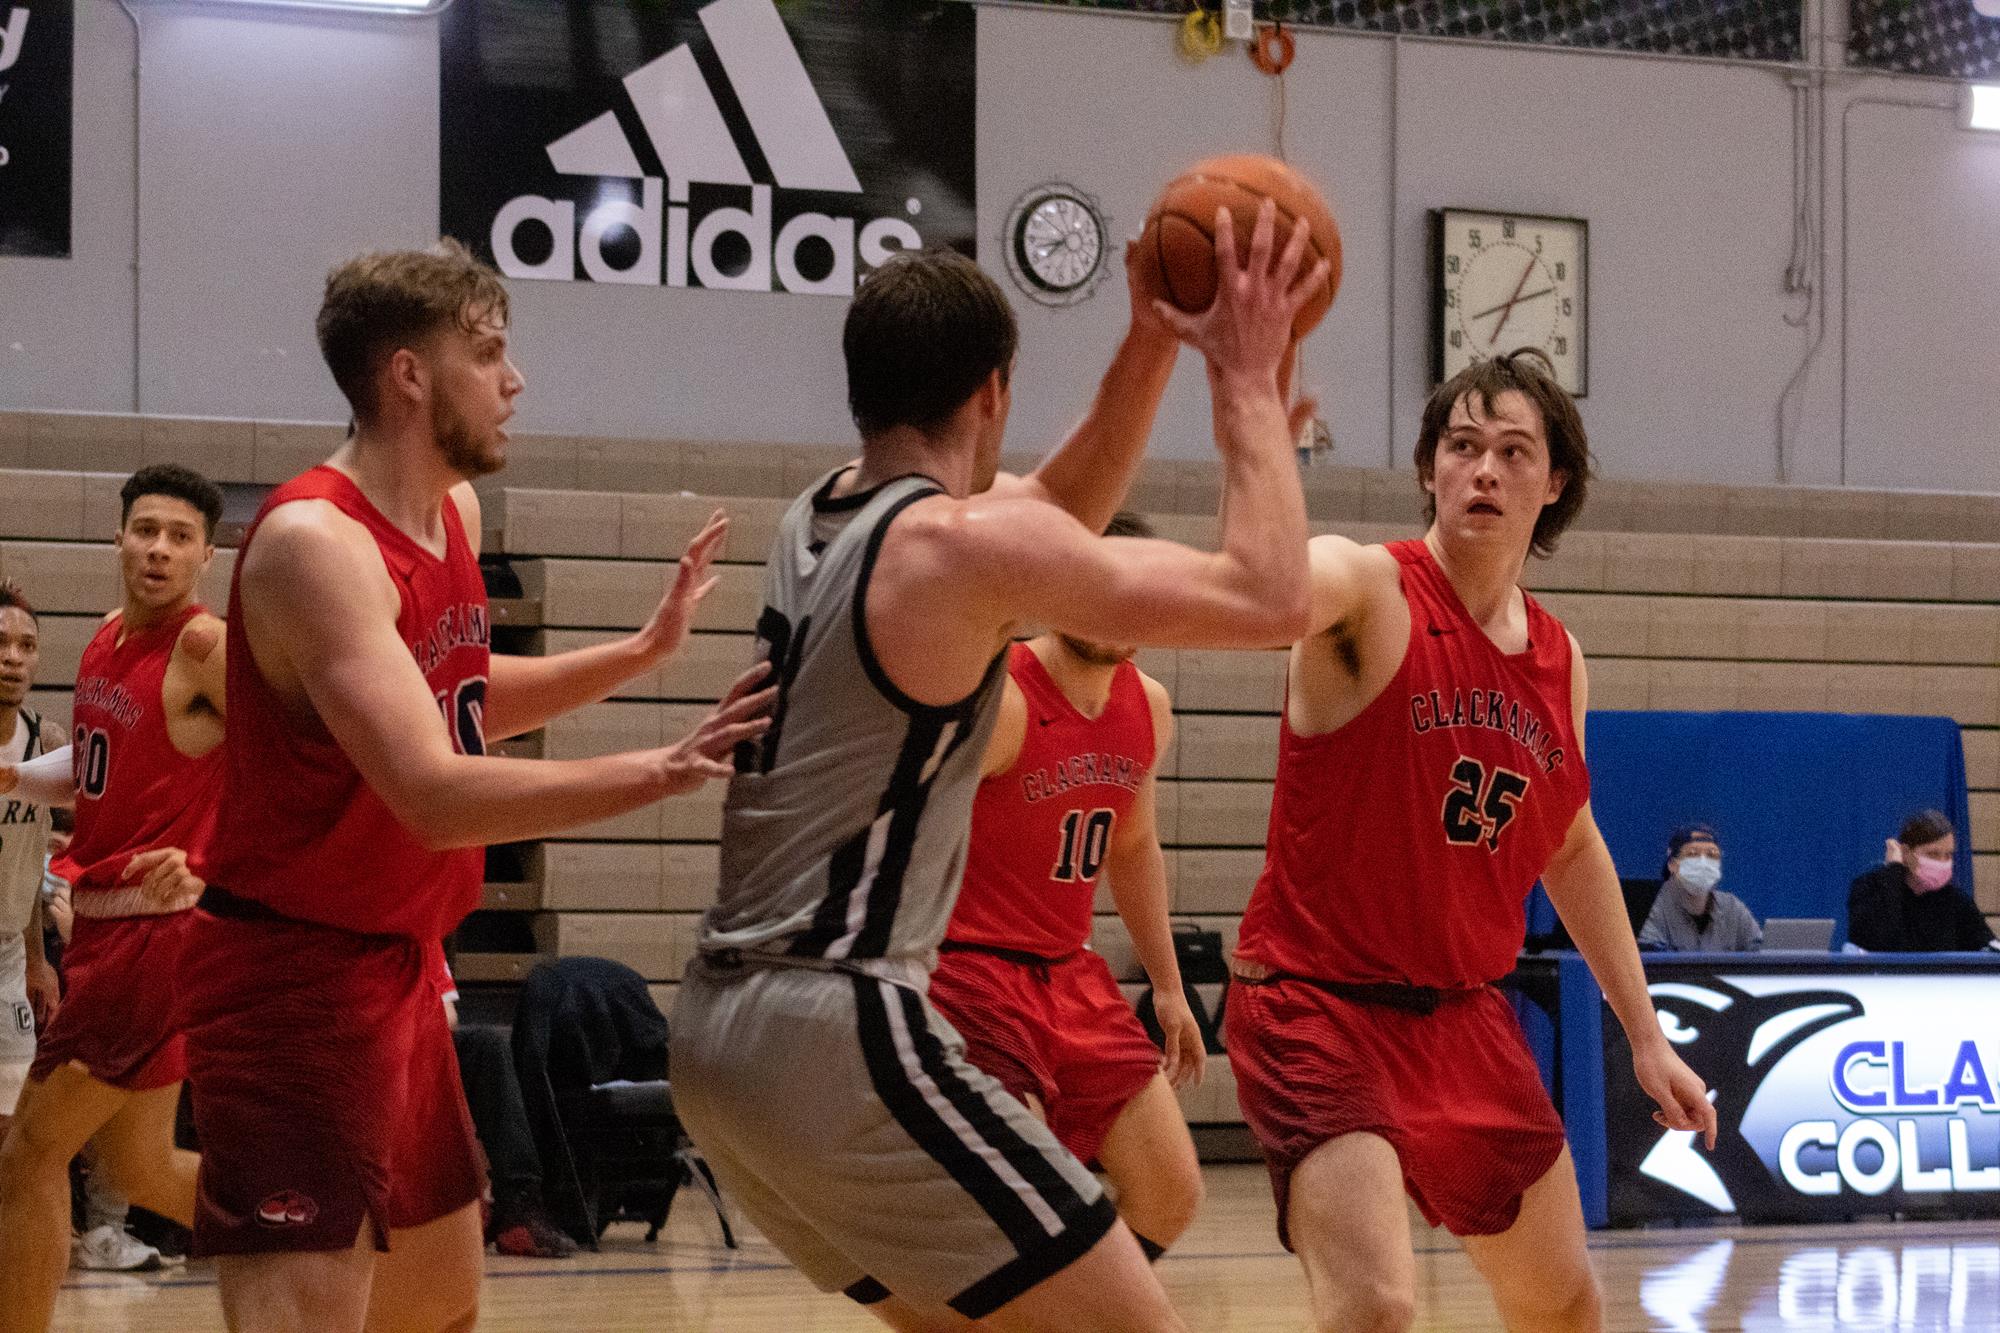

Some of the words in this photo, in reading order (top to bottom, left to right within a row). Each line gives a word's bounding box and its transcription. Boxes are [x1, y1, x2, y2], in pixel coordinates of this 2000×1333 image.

[491, 175, 922, 297] adidas
[1469, 229, 1481, 249] 55
[1535, 234, 1542, 253] 5
[1448, 255, 1460, 274] 50
[1555, 261, 1566, 281] 10
[1562, 297, 1572, 317] 15
[1555, 336, 1567, 356] 20
[1410, 687, 1565, 780] CLACKAMAS
[0, 799, 40, 825] RK
[1441, 754, 1531, 855] 25
[1050, 807, 1117, 883] 10
[1830, 1039, 2000, 1109] CLA
[1779, 1118, 2000, 1196] COLL
